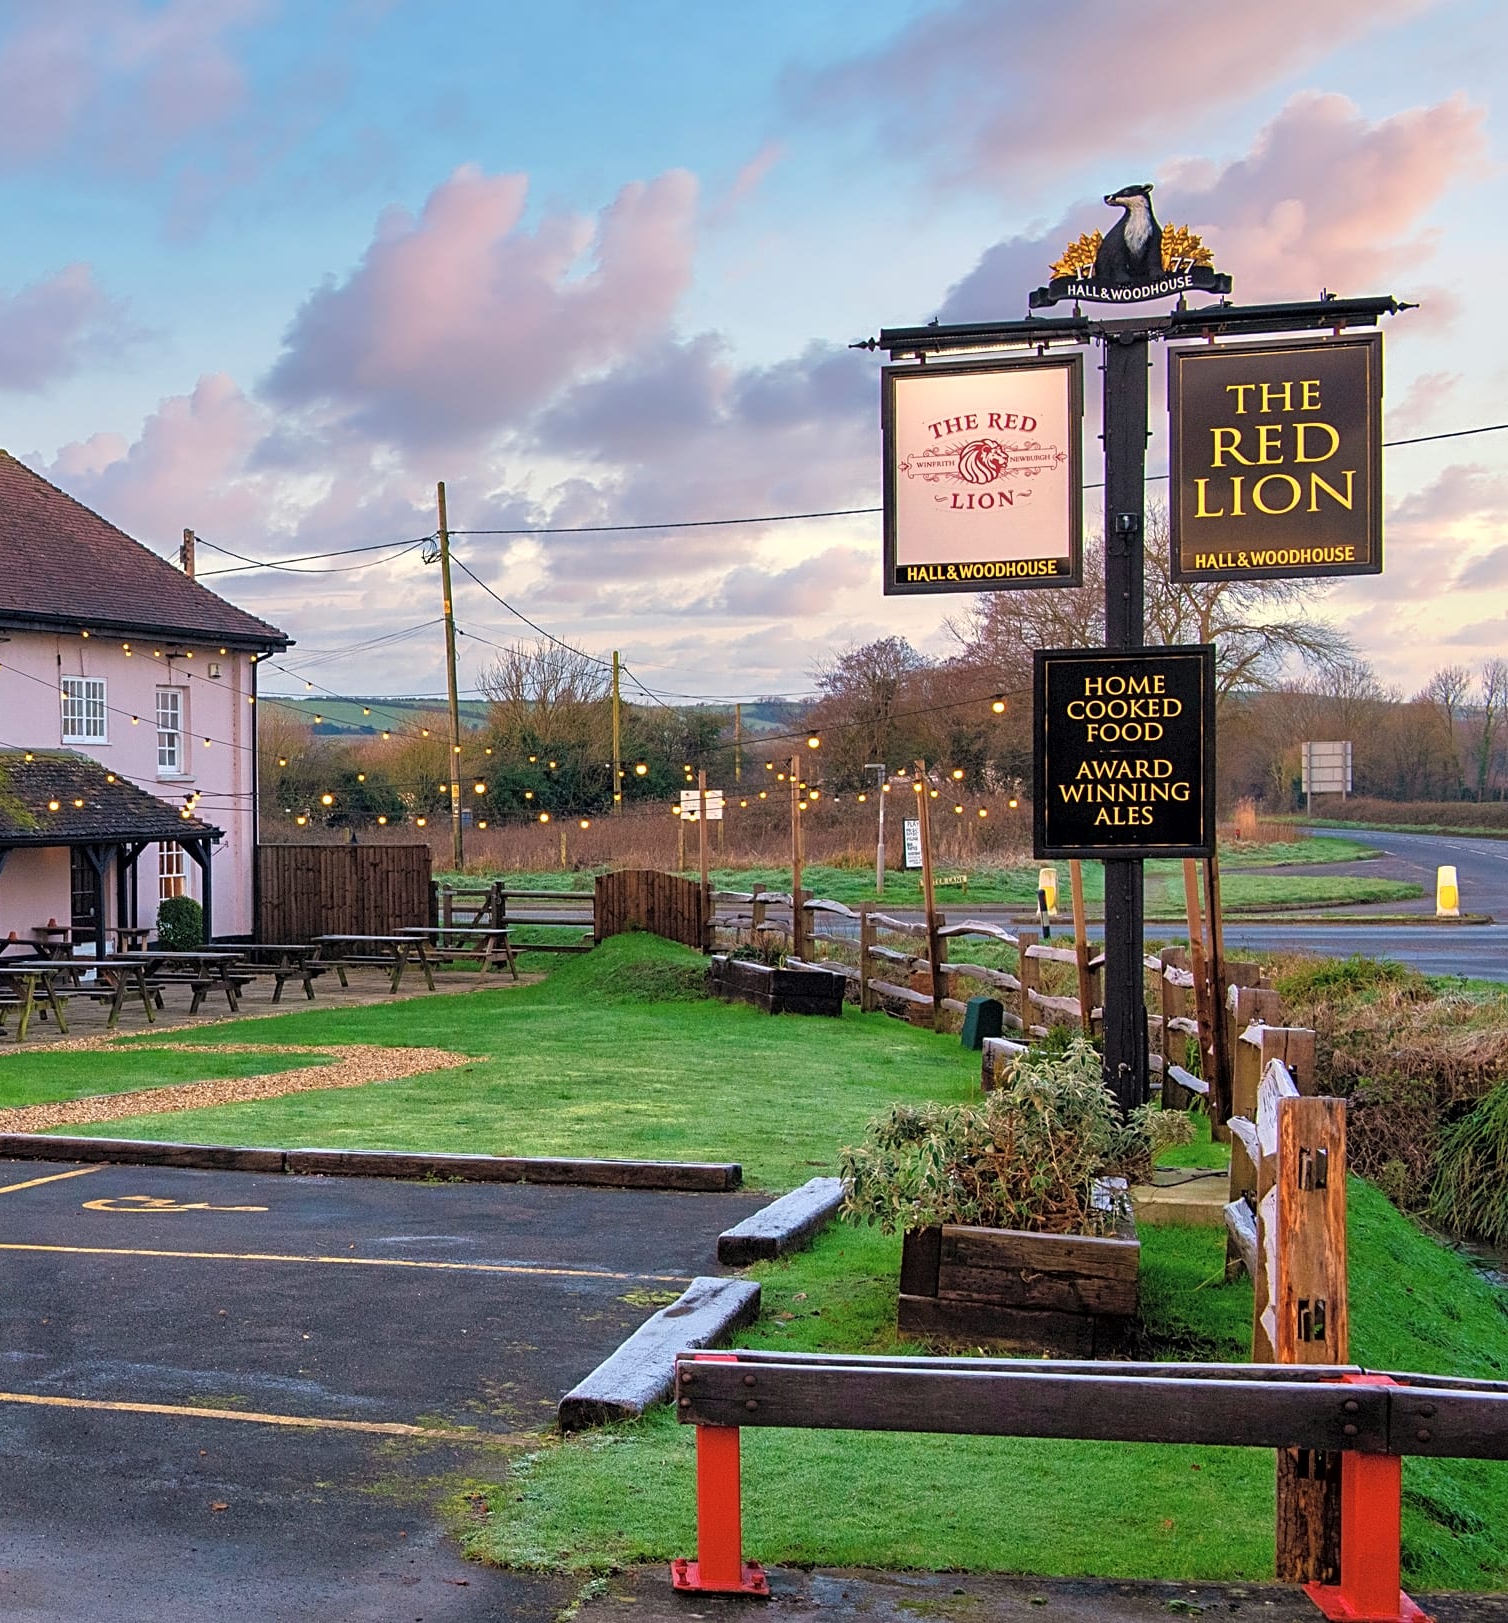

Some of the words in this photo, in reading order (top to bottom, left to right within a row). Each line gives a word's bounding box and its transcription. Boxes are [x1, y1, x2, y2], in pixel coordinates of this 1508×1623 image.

[1225, 379, 1322, 415] THE
[928, 413, 979, 440] THE
[987, 412, 1038, 432] RED
[1209, 422, 1340, 468] RED
[916, 460, 955, 469] WINFRITH
[1009, 454, 1051, 463] NEWBURGH
[950, 489, 1014, 510] LION
[1193, 470, 1357, 518] LION
[1084, 674, 1166, 696] HOME
[1066, 698, 1182, 720] COOKED
[1086, 722, 1164, 743] FOOD
[1075, 759, 1173, 780] AWARD
[1058, 782, 1191, 804] WINNING
[1093, 806, 1154, 826] ALES
